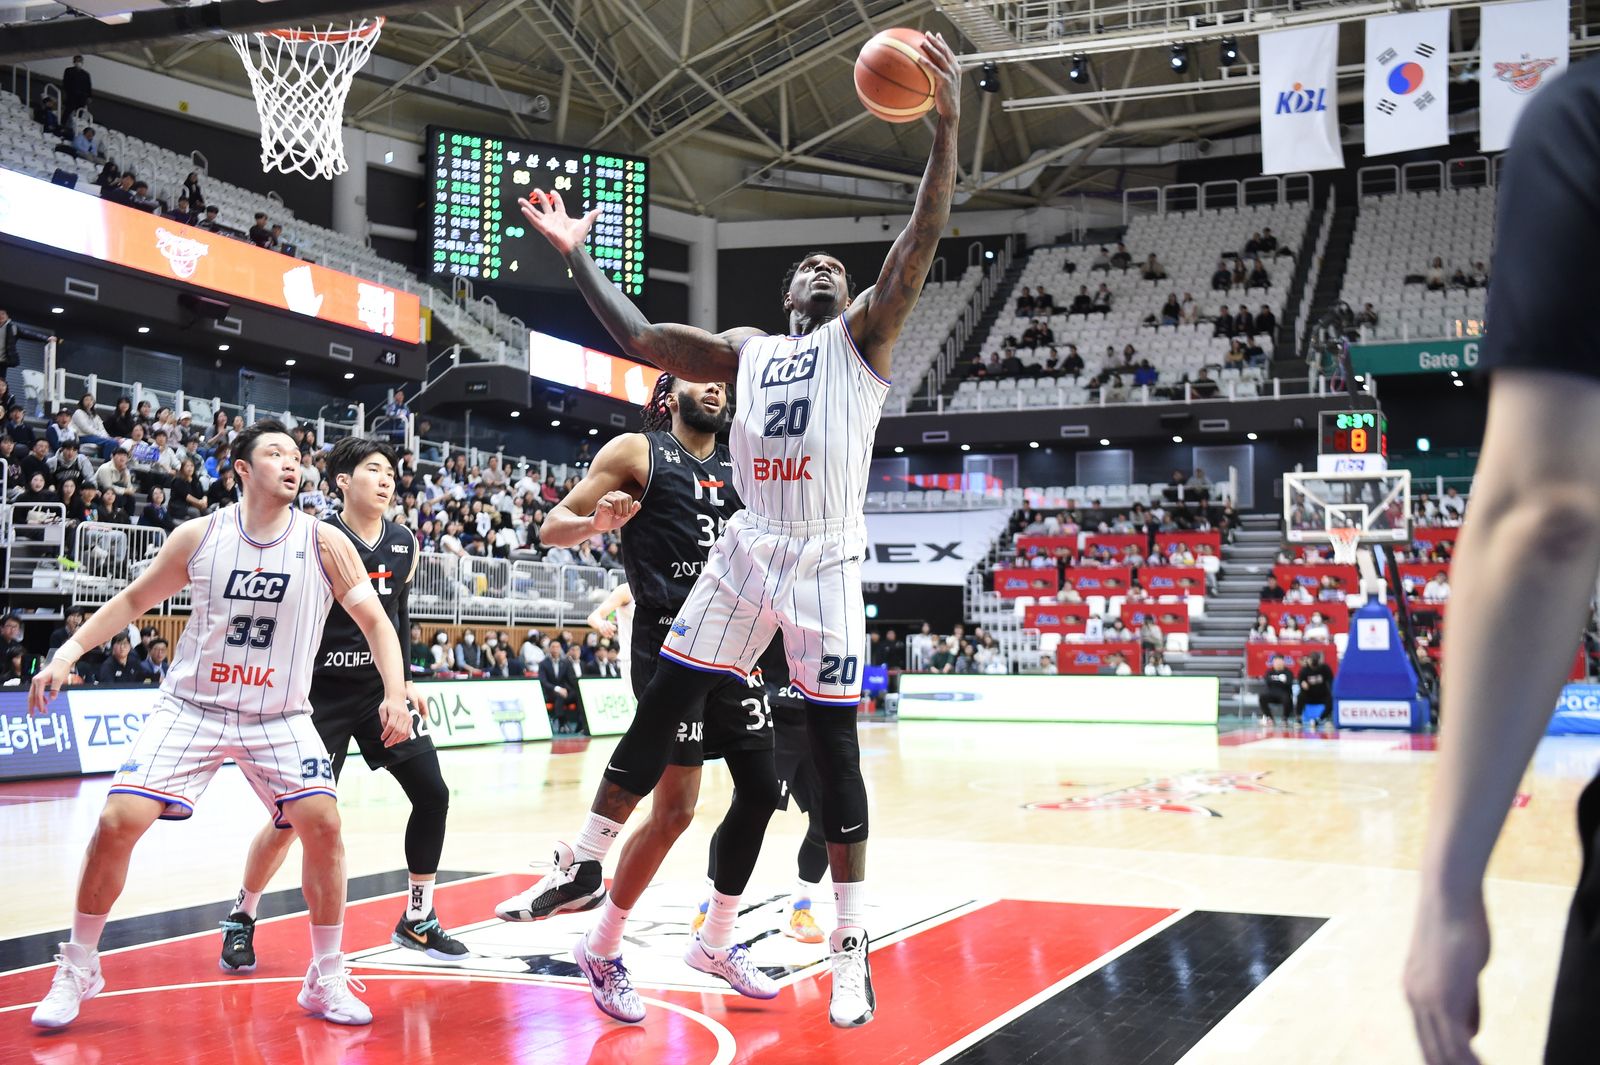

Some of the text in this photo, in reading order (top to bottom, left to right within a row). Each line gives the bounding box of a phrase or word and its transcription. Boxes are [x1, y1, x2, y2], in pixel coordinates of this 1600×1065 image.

[1275, 84, 1327, 114] KBL
[765, 350, 813, 384] KCC
[1419, 352, 1458, 369] Gate
[764, 397, 812, 439] 20
[753, 456, 813, 481] BNK
[862, 541, 964, 563] EX
[230, 568, 284, 599] KCC
[225, 615, 278, 649] 33
[210, 662, 275, 688] BNK
[817, 654, 858, 686] 20
[84, 712, 150, 746] ZES
